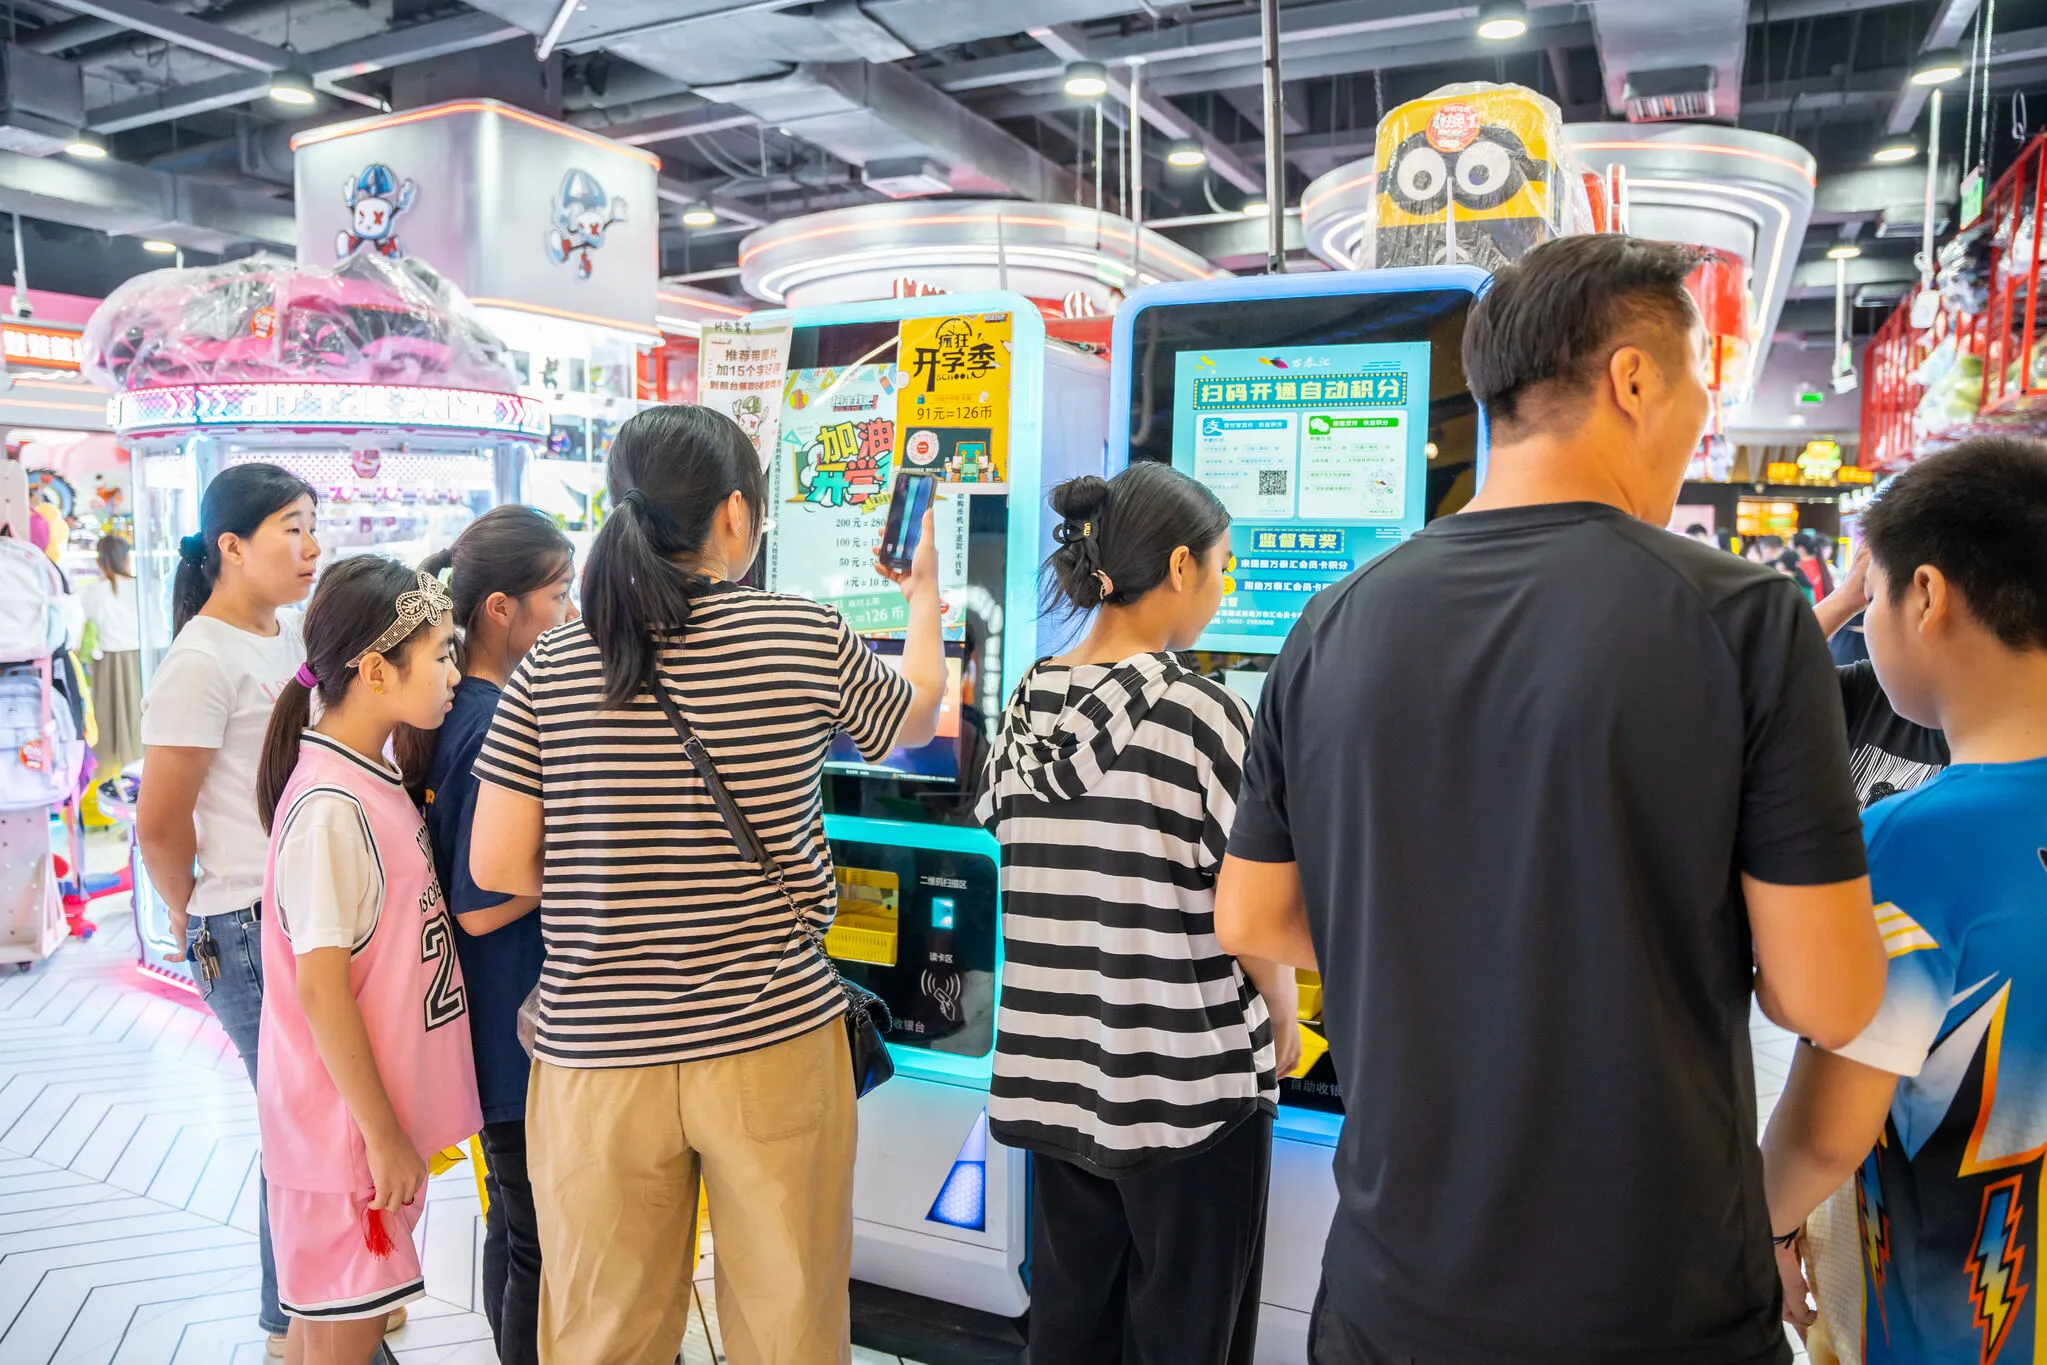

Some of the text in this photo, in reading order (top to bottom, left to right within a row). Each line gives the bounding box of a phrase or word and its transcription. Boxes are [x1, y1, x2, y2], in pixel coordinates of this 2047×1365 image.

[913, 343, 996, 392] 开学季
[1200, 378, 1401, 403] 扫码开通自动积分
[916, 405, 992, 421] 91元=126币
[816, 417, 894, 464] 加油
[1258, 533, 1337, 549] 监督有奖
[920, 876, 968, 890] 二维码扫描区
[929, 951, 953, 964] 读卡区
[421, 911, 466, 1033] 2
